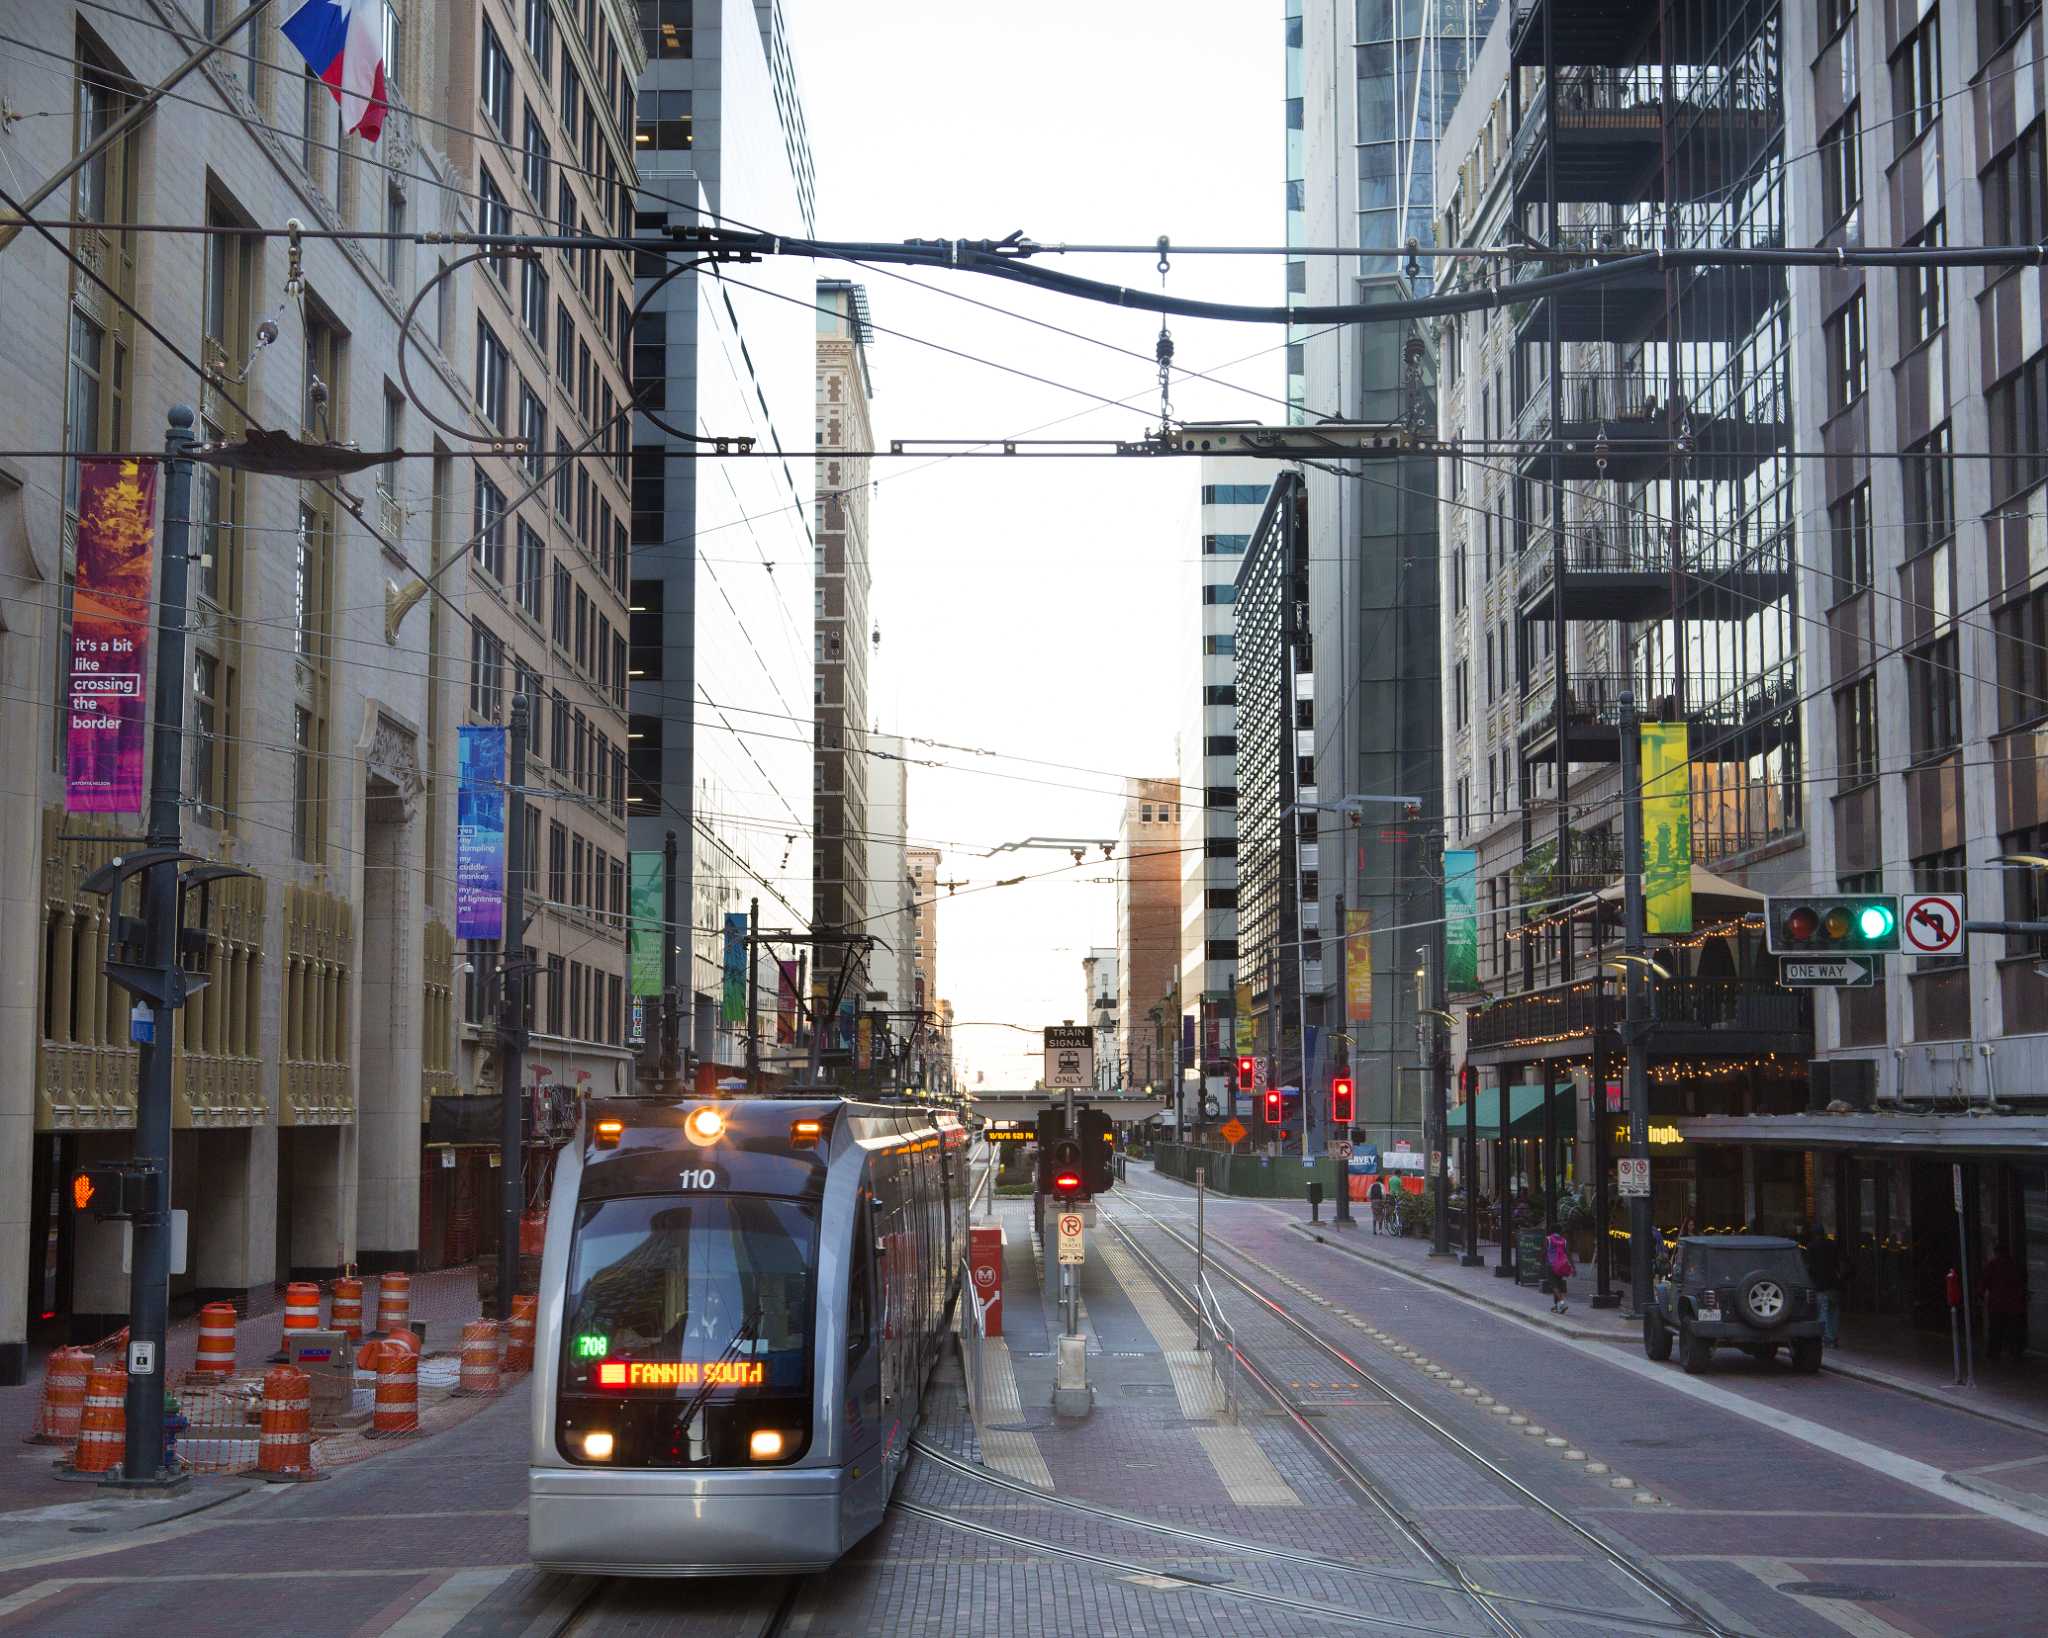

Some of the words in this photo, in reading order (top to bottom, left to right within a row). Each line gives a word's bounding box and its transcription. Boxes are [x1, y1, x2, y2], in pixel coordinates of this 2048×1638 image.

[75, 637, 97, 652] it's
[100, 642, 109, 652] a
[112, 638, 133, 652] bit
[74, 657, 100, 671] like
[73, 676, 134, 693] crossing
[72, 697, 97, 710] the
[72, 715, 122, 729] border
[459, 844, 496, 853] dumpling
[459, 872, 489, 881] monkey
[468, 895, 502, 904] lightning
[1790, 965, 1816, 978] ONE
[1819, 965, 1844, 977] WAY
[1053, 1028, 1086, 1037] TRAIN
[1048, 1039, 1089, 1048] SIGNAL
[1054, 1075, 1084, 1084] ONLY
[679, 1168, 716, 1189] 110
[630, 1362, 698, 1383] FANNIN
[703, 1362, 762, 1383] SOUTH
